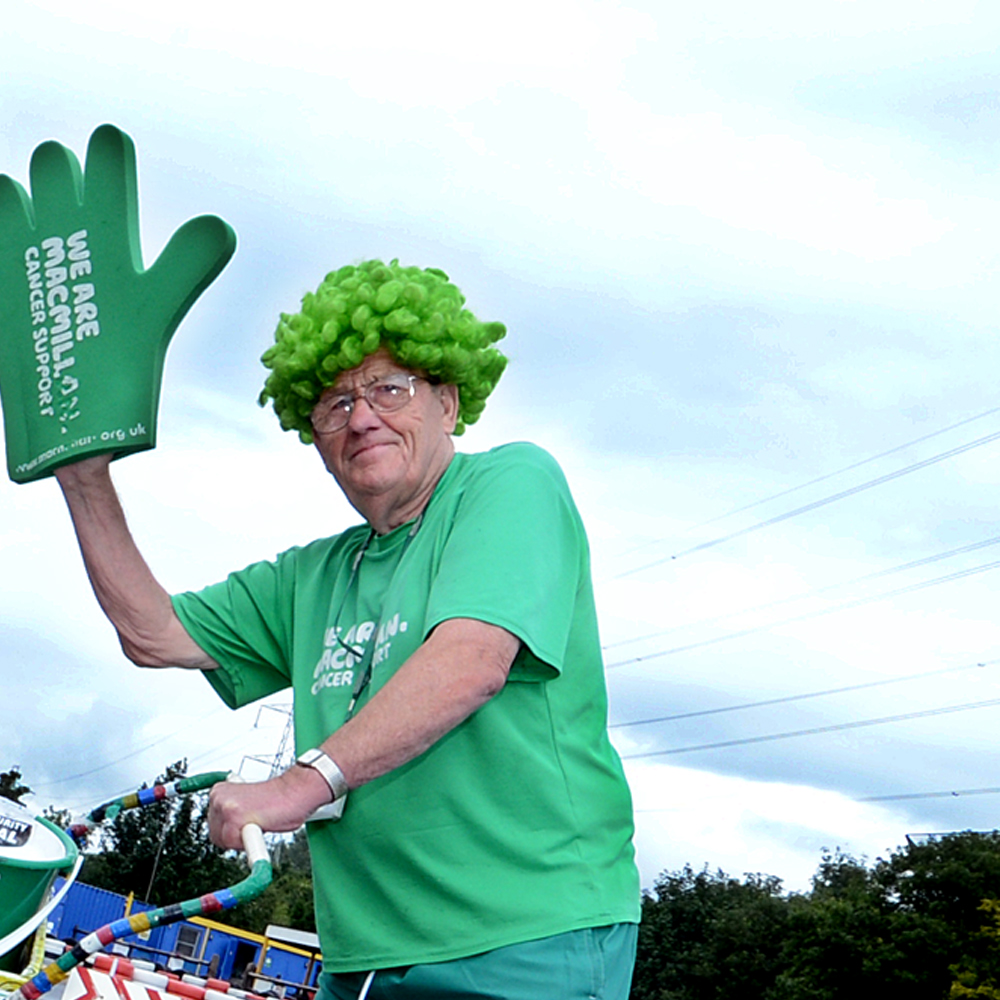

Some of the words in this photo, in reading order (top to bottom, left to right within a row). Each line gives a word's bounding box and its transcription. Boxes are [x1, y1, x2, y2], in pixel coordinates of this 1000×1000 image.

[66, 229, 92, 280] WE
[24, 246, 46, 325] CANCER
[72, 283, 100, 341] ARE
